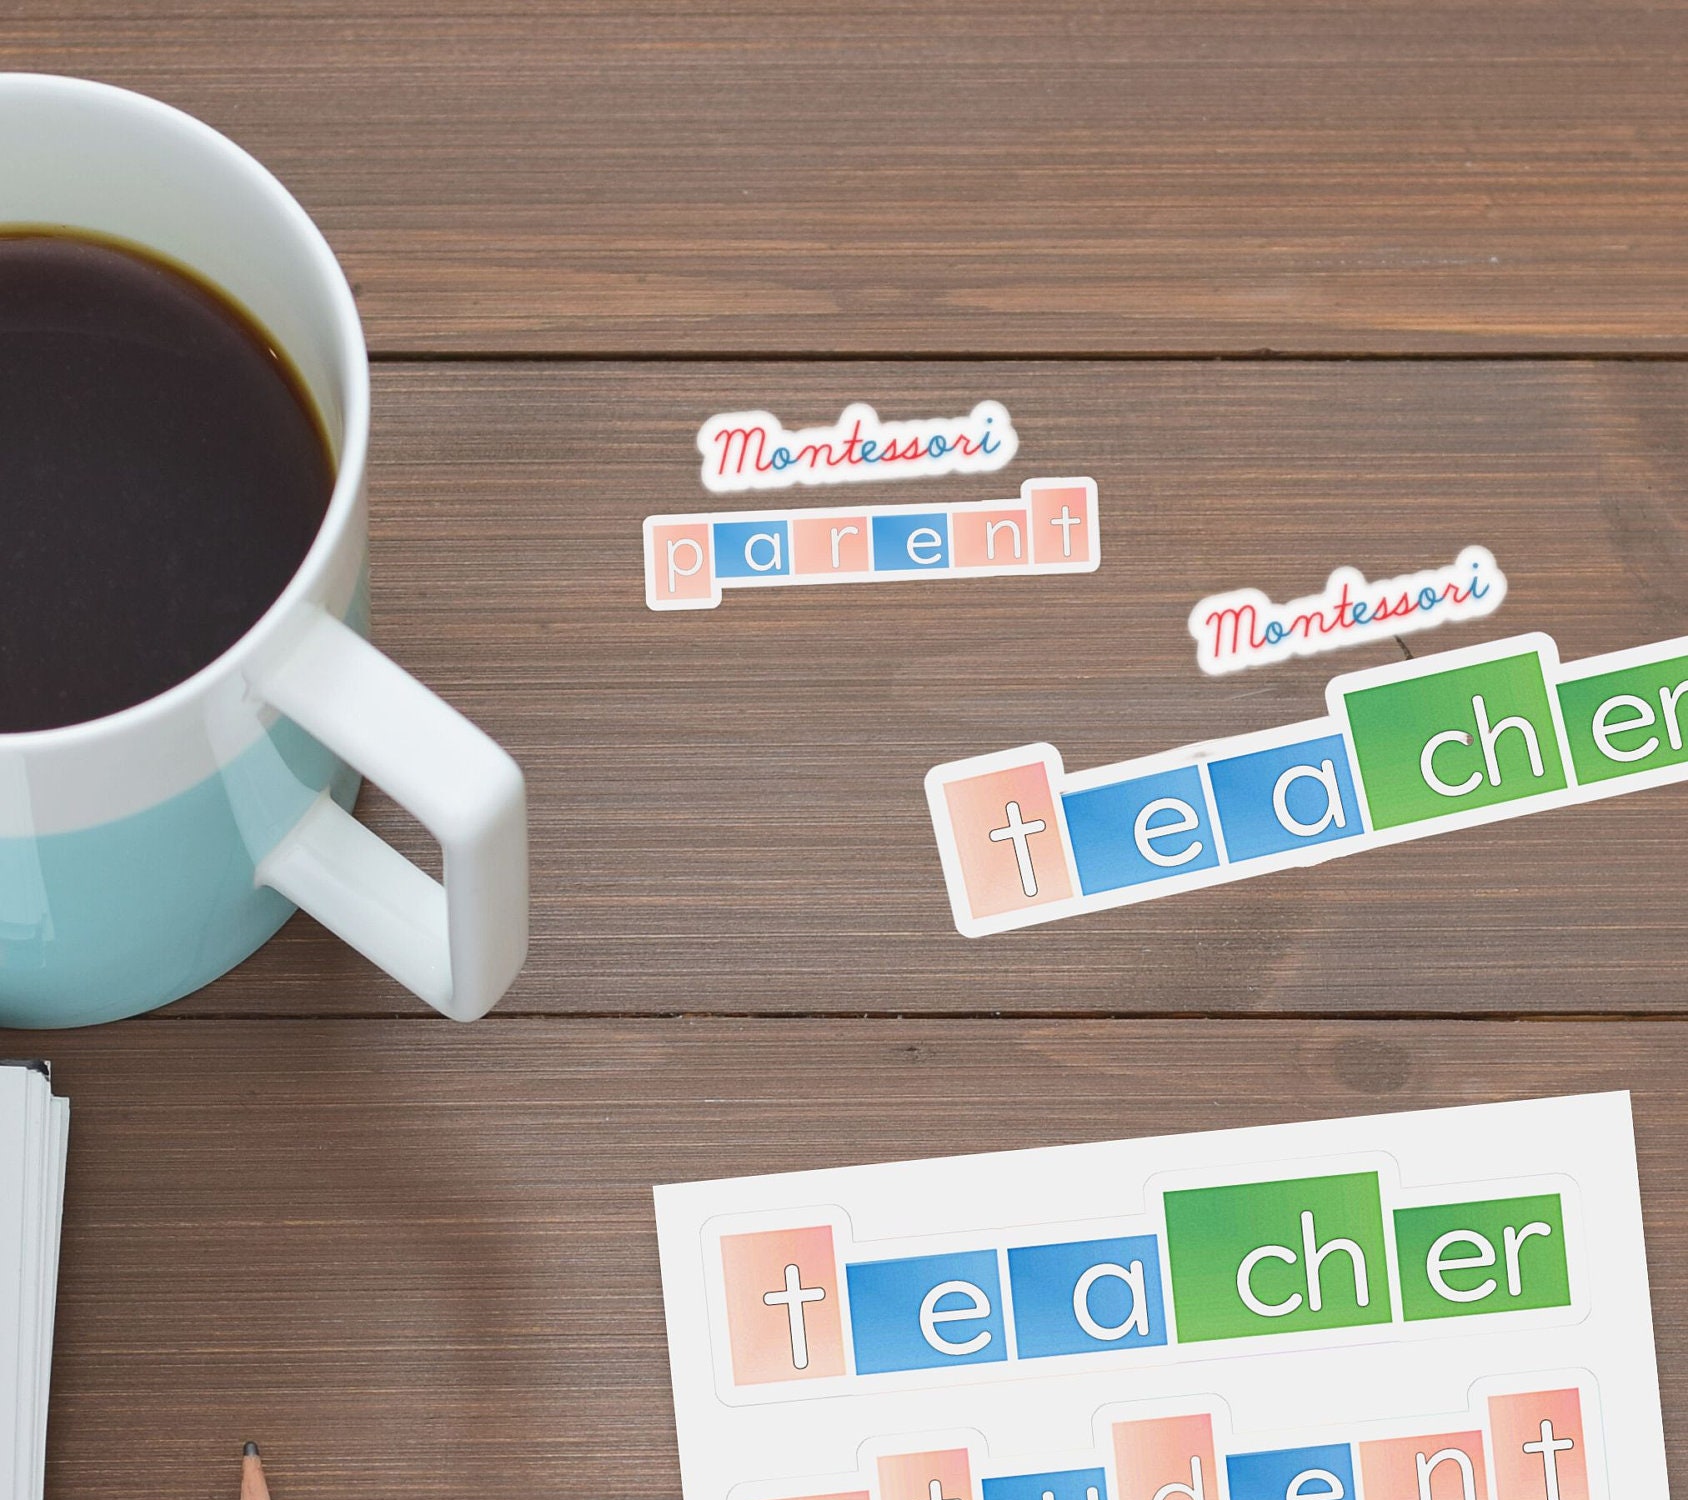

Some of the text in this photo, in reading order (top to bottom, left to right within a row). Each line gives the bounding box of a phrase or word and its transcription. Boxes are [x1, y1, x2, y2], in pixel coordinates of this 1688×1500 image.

[715, 417, 1001, 475] Montessori
[666, 505, 1081, 593] parent
[1206, 563, 1490, 657] Montessori
[989, 679, 1688, 897] teacher
[763, 1209, 1552, 1370] teacher
